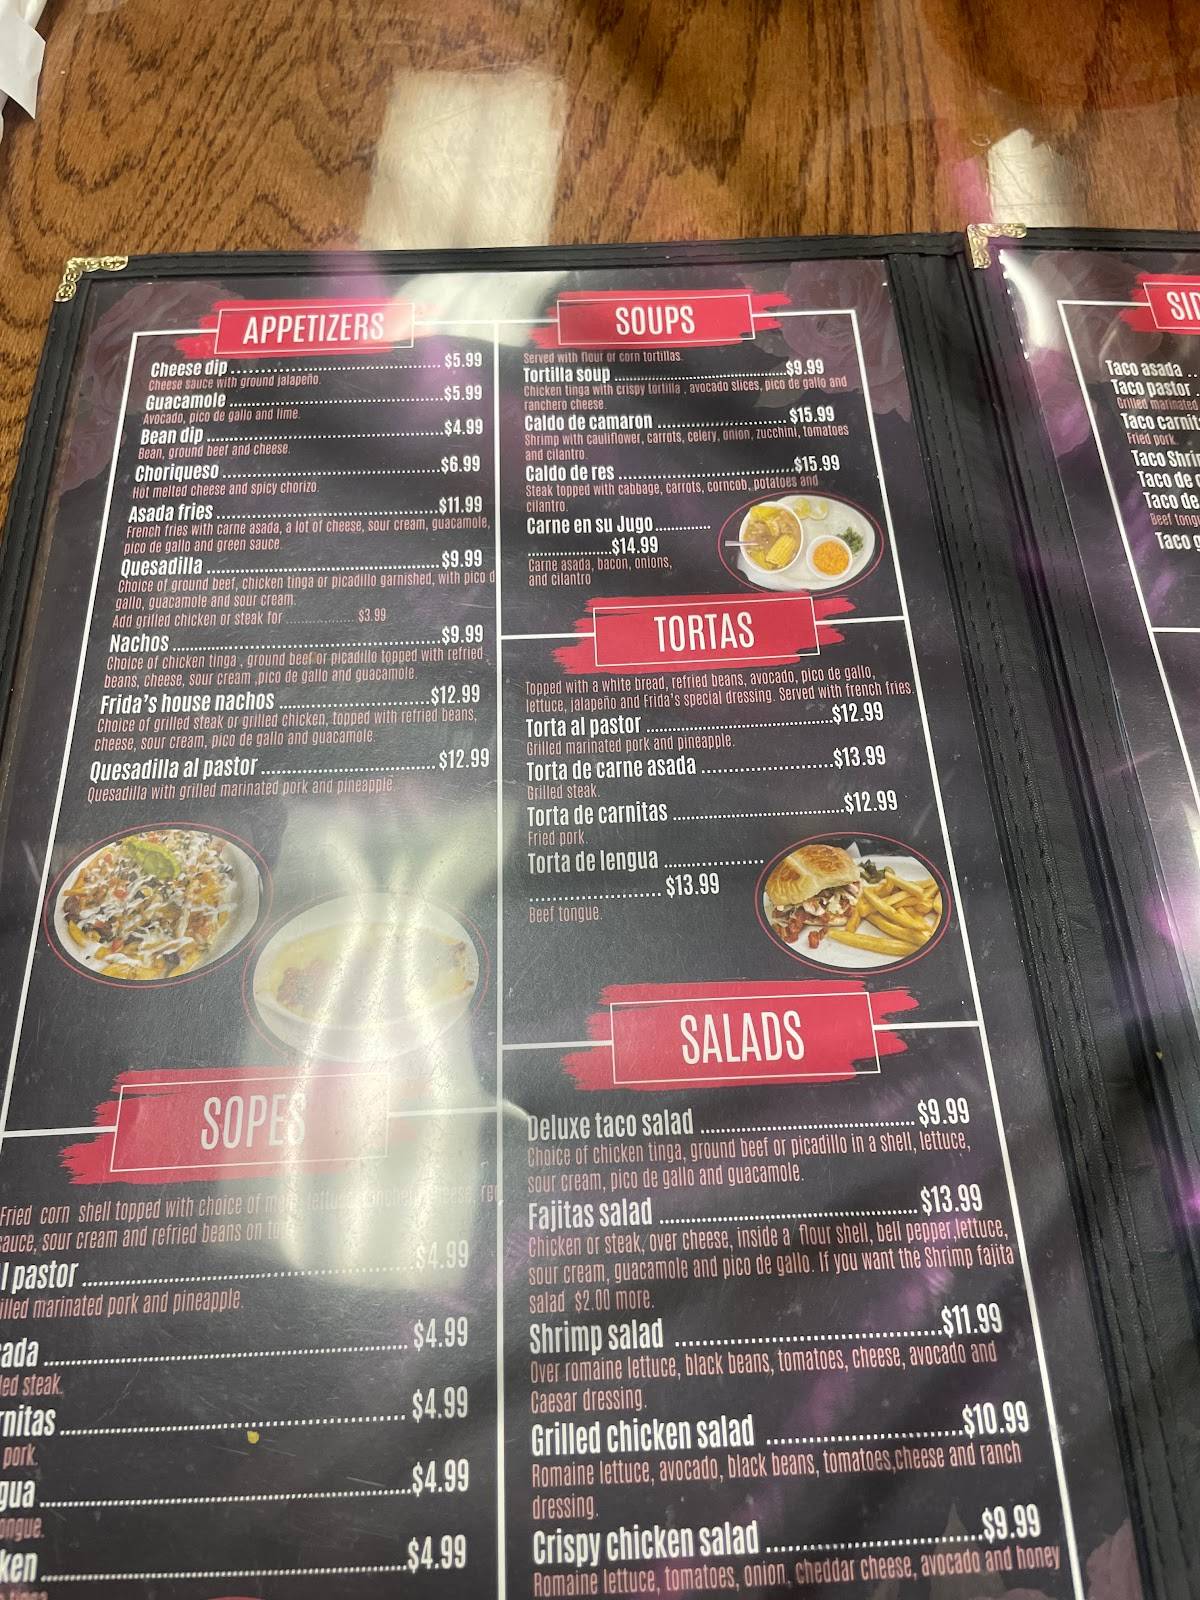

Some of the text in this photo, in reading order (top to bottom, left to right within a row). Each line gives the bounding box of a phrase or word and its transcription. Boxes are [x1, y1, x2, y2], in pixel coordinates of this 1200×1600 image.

[243, 312, 384, 344] APPETIZERS
[615, 306, 696, 335] SOUPS
[150, 352, 482, 377] Cheese dip $5.99
[522, 351, 554, 364] Served
[556, 351, 577, 363] with
[606, 352, 615, 361] or
[619, 352, 639, 361] corn
[522, 358, 824, 383] Tortilla soup $9.99
[1104, 359, 1182, 376] Taco asada
[148, 378, 182, 391] Cheese
[184, 378, 213, 389] sauce
[216, 376, 237, 388] with
[240, 375, 274, 388] ground
[1110, 378, 1190, 397] Taco pastor
[145, 384, 482, 410] Guacamole $5.99
[140, 418, 482, 444] Bean dip $4.99
[524, 405, 834, 431] Caldo de camaron $15.99
[1120, 412, 1155, 429] Taco
[1126, 432, 1151, 444] Fried
[134, 455, 480, 482] Choriqueso $6.99
[525, 454, 840, 481] Caldo de res $15.99
[1130, 449, 1166, 466] Taco
[1136, 470, 1172, 487] Taco
[1173, 471, 1193, 488] de
[128, 495, 482, 523] Asada fries $11.99
[1142, 491, 1199, 509] Taco de
[526, 515, 652, 534] Carne en su Jugo
[1149, 512, 1172, 525] Beef
[612, 535, 658, 556] $14.99
[1154, 531, 1191, 549] Taco
[120, 549, 482, 578] Quesadilla $9.99
[112, 607, 386, 628] Add grilled chicken or steak for $3.99
[109, 624, 482, 652] Nachos $9.99
[654, 611, 755, 652] TORTAS
[160, 693, 210, 712] house
[214, 691, 274, 710] nachos
[430, 684, 479, 706] $12.99
[525, 701, 883, 738] Torta al pastor $12.99
[526, 732, 734, 755] Grilled marinated pork and pineapple.
[89, 747, 489, 783] Quesadilla al pastor $12.99
[526, 744, 885, 781] Torta de carne asada $13.99
[527, 782, 599, 800] Grilled steak.
[526, 789, 897, 826] Torta de carnitas $12.99
[528, 828, 587, 846] Fried pork.
[527, 850, 658, 874] Torta de lengua
[665, 872, 719, 898] $13.99
[529, 905, 602, 923] Beef tongue.
[680, 1010, 804, 1064] SALADS
[201, 1094, 306, 1150] SOPES
[528, 1097, 969, 1141] Deluxe taco salad $9.99
[528, 1183, 982, 1232] Fajitas salad $13.99
[11, 1260, 78, 1294] pastor
[416, 1239, 468, 1274] $4.99
[32, 1294, 103, 1318] marinated
[107, 1292, 139, 1317] pork
[142, 1291, 168, 1313] and
[172, 1287, 243, 1314] pineapple.
[529, 1289, 654, 1314] salad $2.00 more.
[413, 1316, 467, 1352] $4.99
[529, 1302, 1002, 1355] Shrimp salad $11.99
[412, 1386, 467, 1422] $4.99
[530, 1388, 646, 1413] Caesar dressing.
[531, 1401, 1028, 1456] Grilled chicken salad $10.99
[2, 1444, 37, 1469] pork.
[412, 1458, 468, 1496] $4.99
[533, 1506, 1040, 1567] Crispy chicken salad $9.99
[407, 1534, 465, 1573] $4.99
